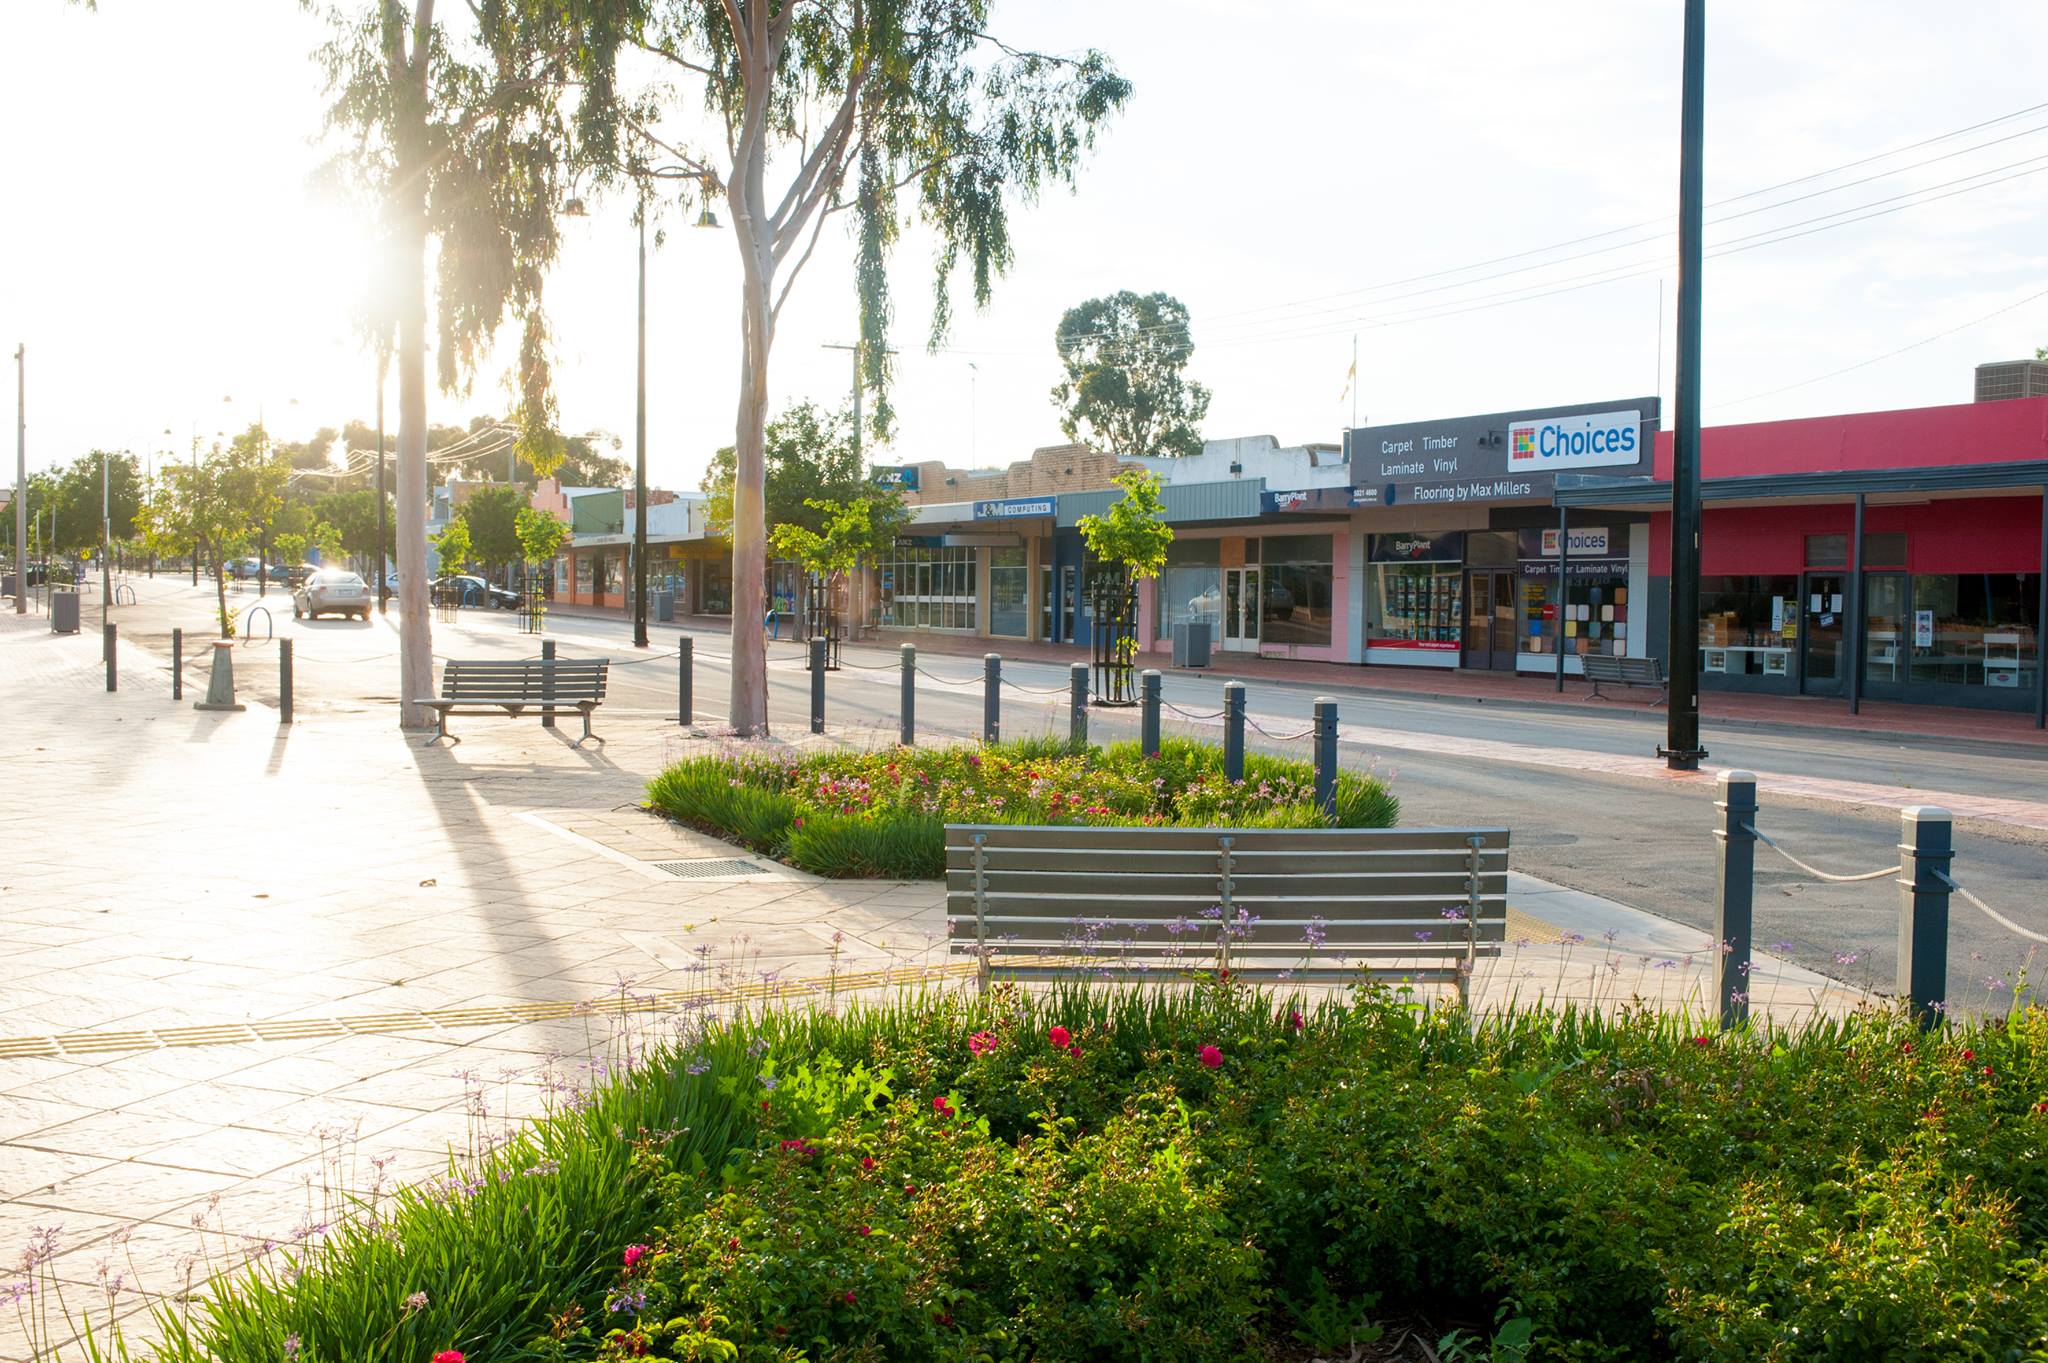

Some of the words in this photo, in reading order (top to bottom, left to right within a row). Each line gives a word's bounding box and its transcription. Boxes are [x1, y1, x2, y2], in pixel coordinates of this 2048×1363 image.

[1381, 440, 1413, 455] Carpet
[1423, 435, 1458, 450] Timber
[1540, 421, 1635, 458] Choices
[1381, 461, 1425, 476] Laminate
[1433, 457, 1458, 474] Vinyl
[1414, 485, 1455, 501] Flooring
[1457, 484, 1468, 500] by
[1470, 482, 1492, 497] Max
[1494, 481, 1531, 495] Millers
[1007, 504, 1049, 514] COMPUTING
[1524, 564, 1547, 575] Carpet
[1549, 564, 1573, 574] Timer
[1576, 563, 1608, 573] Laminate
[1610, 563, 1628, 574] Vinyl
